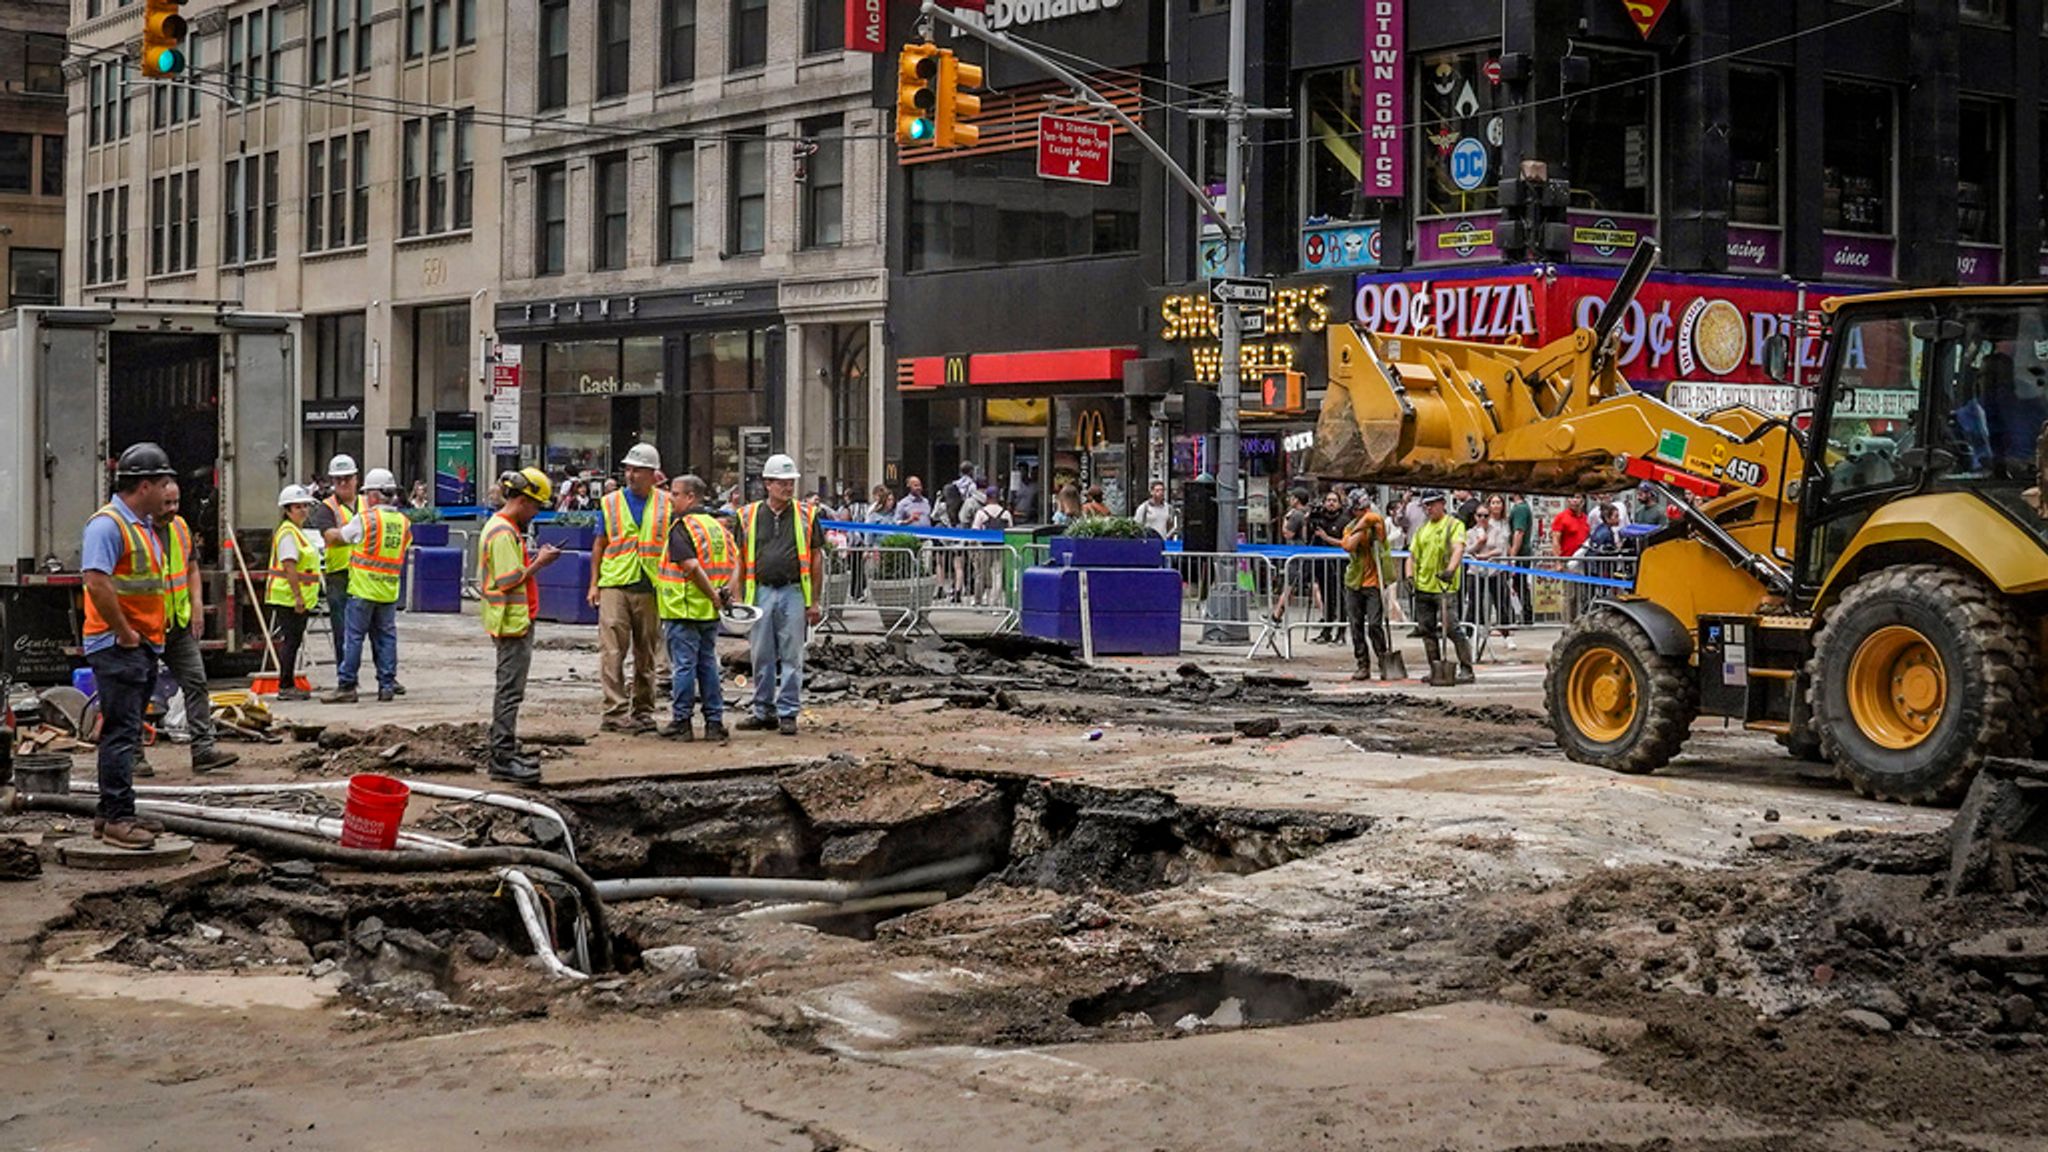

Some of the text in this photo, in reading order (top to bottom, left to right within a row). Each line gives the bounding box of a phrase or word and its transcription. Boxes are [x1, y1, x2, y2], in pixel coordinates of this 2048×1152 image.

[1370, 2, 1397, 188] DTOWN COMICS
[1066, 122, 1097, 137] Standing
[1048, 144, 1101, 161] Except Sunday
[1454, 150, 1483, 180] DC
[1834, 246, 1870, 267] since
[1218, 285, 1263, 298] ONE WAY
[1356, 281, 1535, 337] 99¢ PIZZA
[1193, 344, 1294, 382] WRLD
[580, 374, 618, 393] Cash
[1726, 456, 1760, 485] 450
